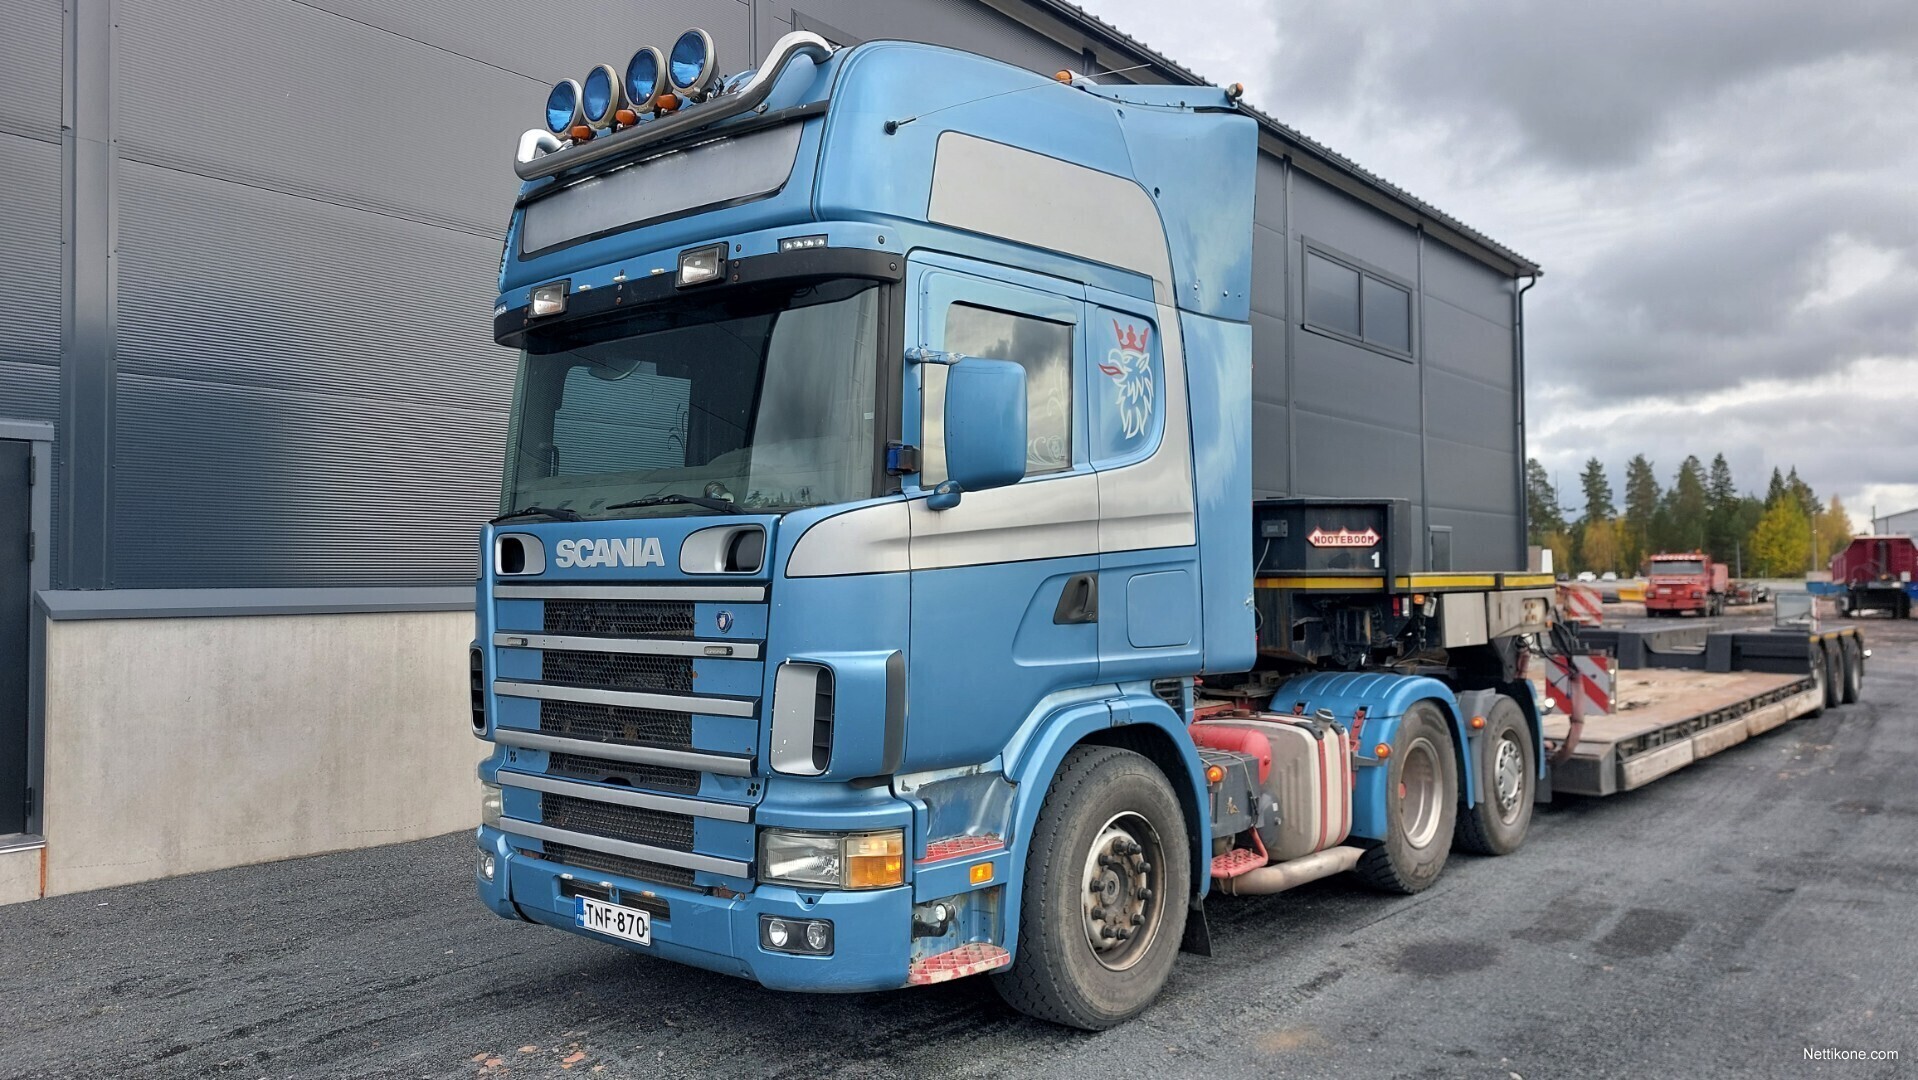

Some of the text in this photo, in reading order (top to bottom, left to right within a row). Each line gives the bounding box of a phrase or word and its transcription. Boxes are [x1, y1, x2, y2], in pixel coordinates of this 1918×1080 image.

[1313, 535, 1375, 545] NOOTEBOOM
[555, 537, 666, 568] SCANIA
[1371, 551, 1380, 569] 1
[586, 903, 645, 938] TNF-870
